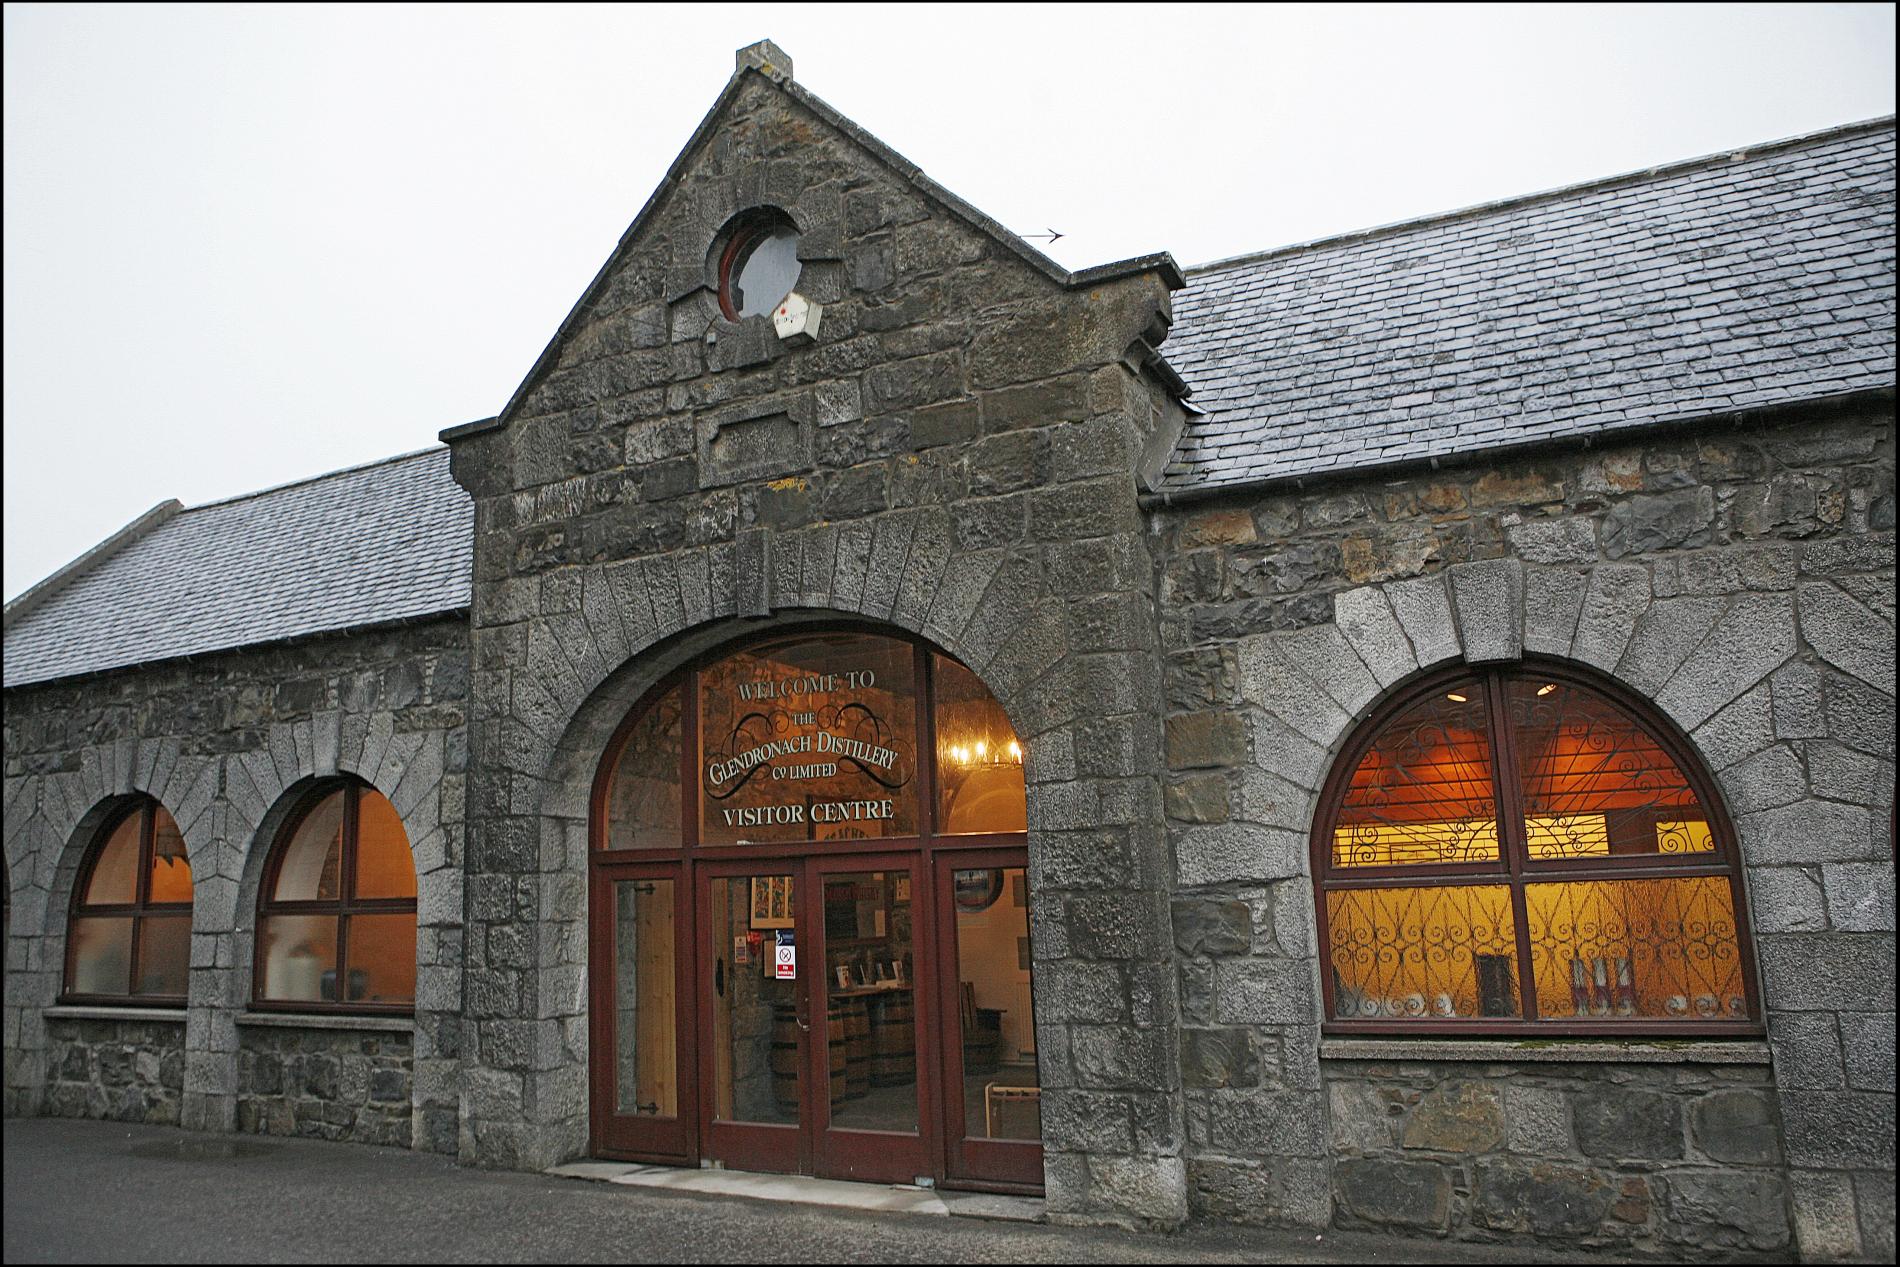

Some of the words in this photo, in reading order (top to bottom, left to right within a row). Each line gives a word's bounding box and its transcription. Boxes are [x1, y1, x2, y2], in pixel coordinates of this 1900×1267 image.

[738, 674, 839, 701] WELCOME
[845, 669, 875, 689] TO
[791, 712, 816, 725] THE
[709, 735, 811, 785] GLENDRONACH
[817, 731, 898, 770] DISTILLERY
[790, 763, 837, 779] LIMITED
[723, 804, 804, 827] VISITOR
[810, 799, 894, 823] CENTRE
